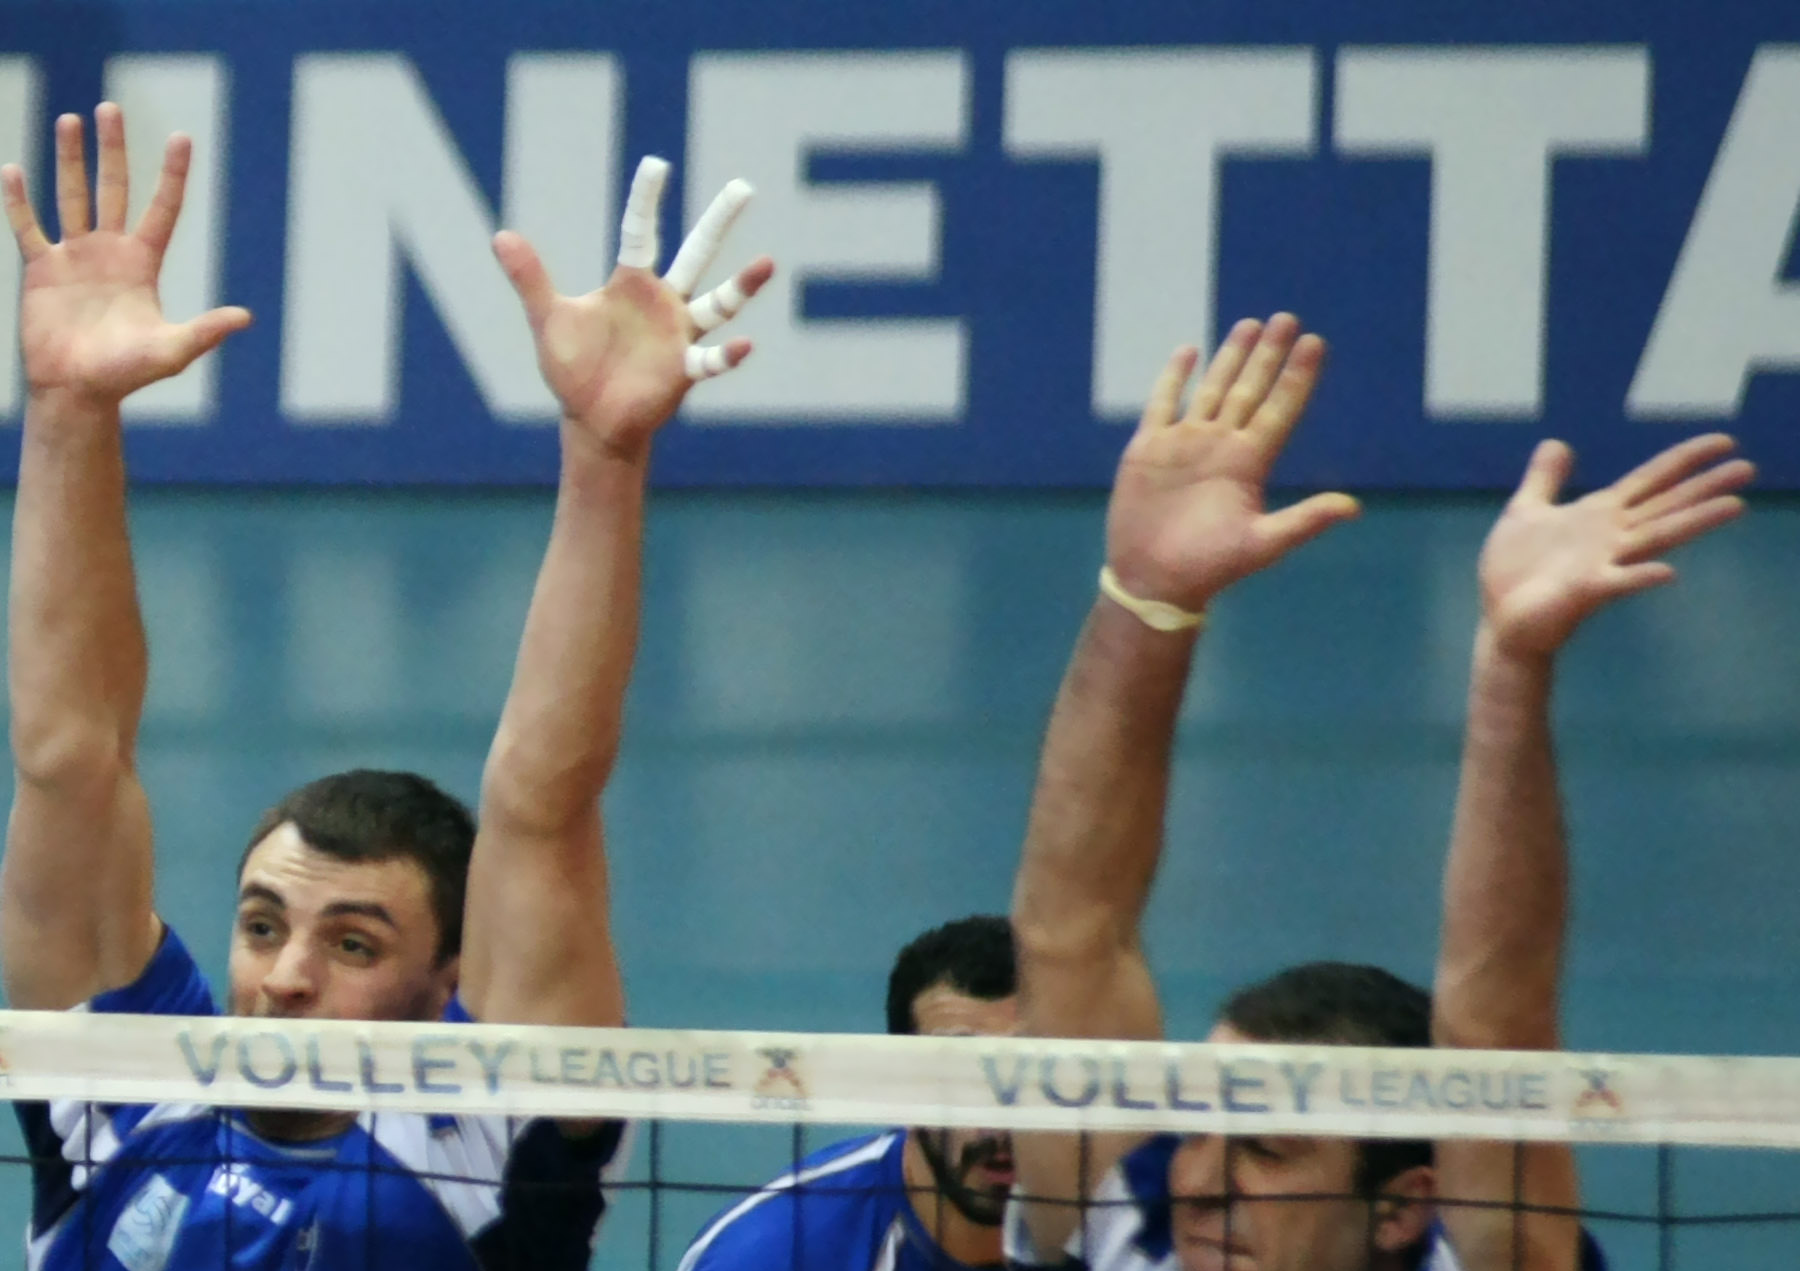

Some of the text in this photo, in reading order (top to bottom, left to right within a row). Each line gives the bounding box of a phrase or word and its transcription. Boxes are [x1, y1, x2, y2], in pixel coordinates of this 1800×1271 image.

[176, 1030, 731, 1096] VOLLEY LEAGUE
[981, 1053, 1548, 1114] VOLLEY LEAGUE
